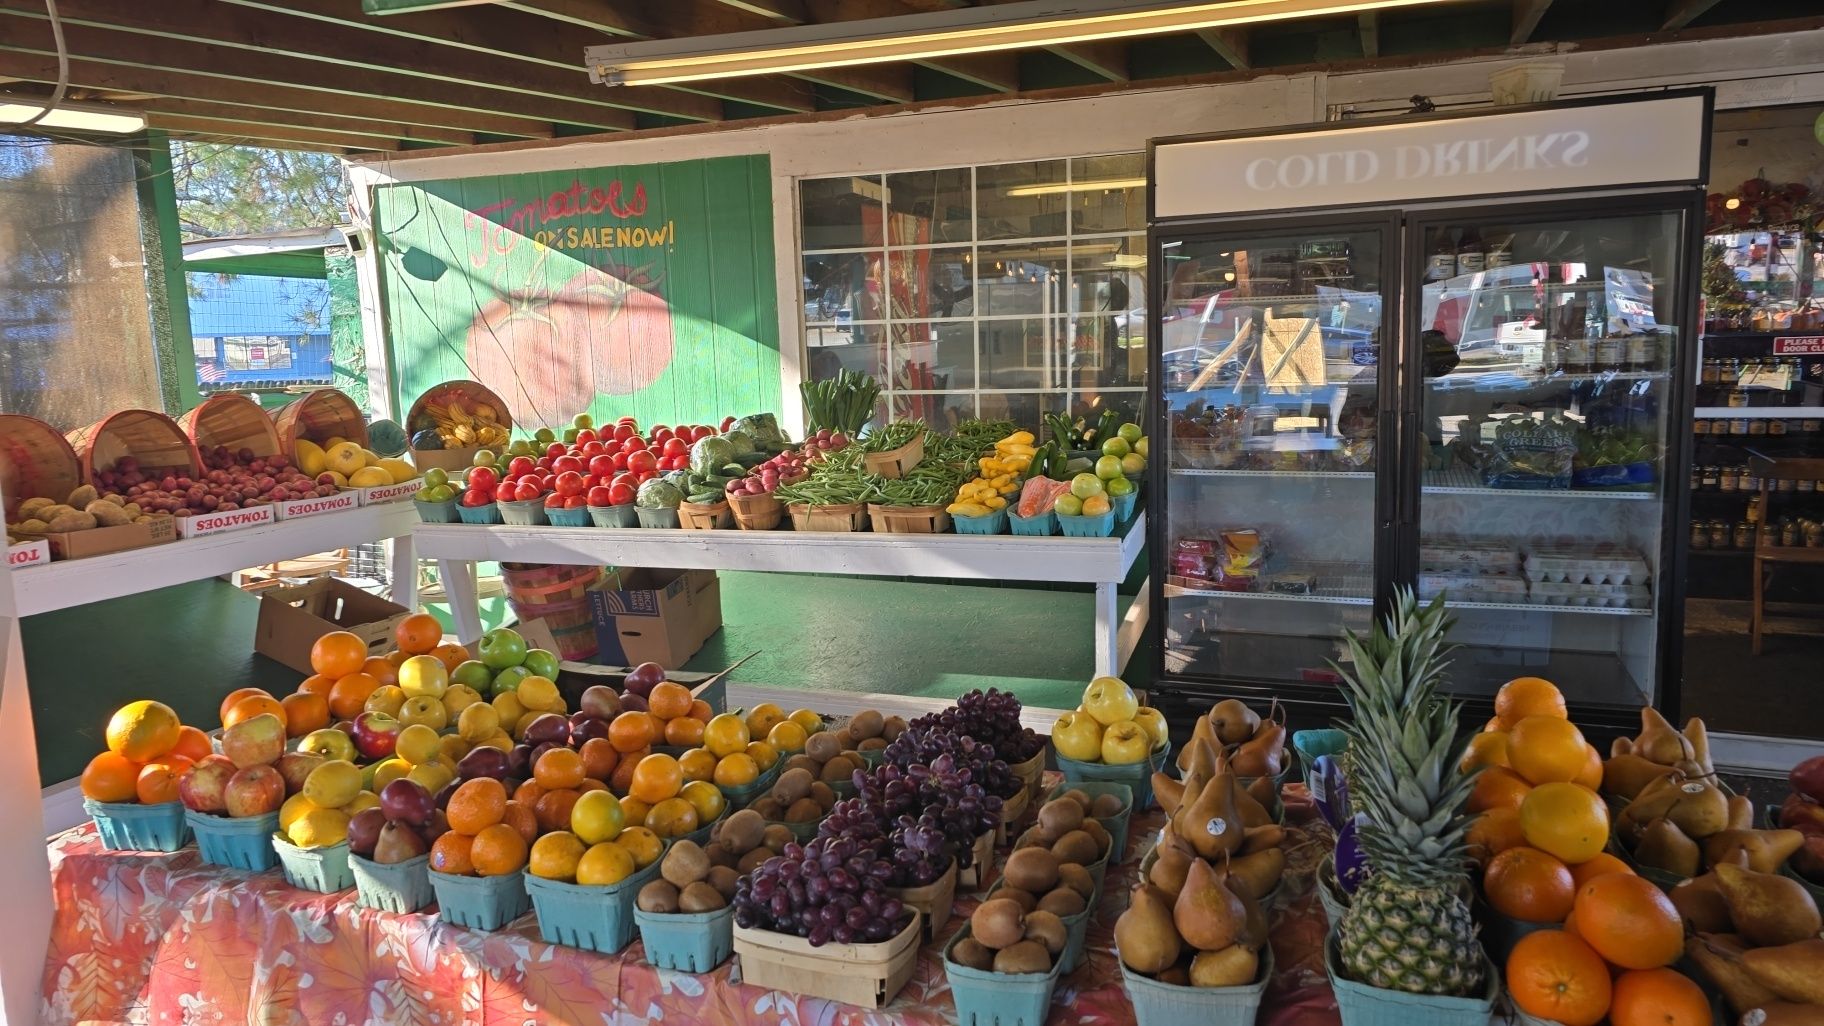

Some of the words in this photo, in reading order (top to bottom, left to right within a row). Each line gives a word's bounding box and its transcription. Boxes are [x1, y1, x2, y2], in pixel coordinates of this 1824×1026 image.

[567, 227, 614, 249] SALE
[1784, 338, 1819, 346] PLEASE
[1510, 437, 1573, 447] GREENS
[369, 482, 422, 500] TOMATOES
[288, 497, 352, 516] TOMATOES
[196, 510, 269, 531] TOMATOES
[593, 594, 606, 627] LETTUCE
